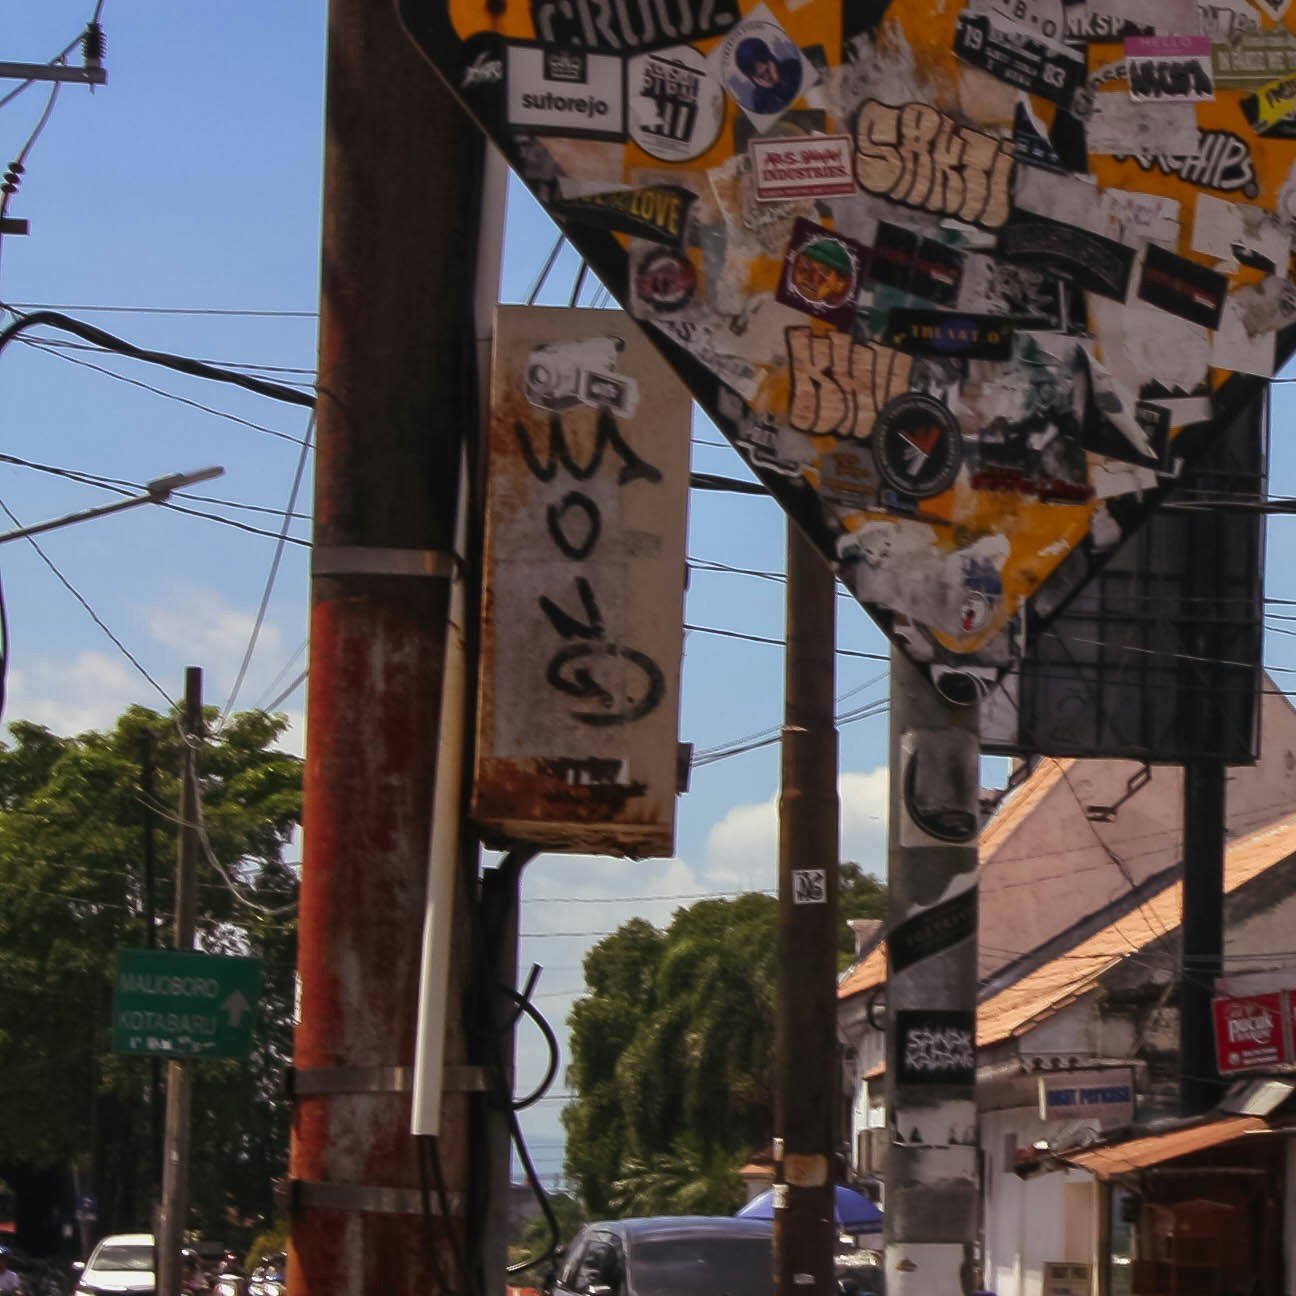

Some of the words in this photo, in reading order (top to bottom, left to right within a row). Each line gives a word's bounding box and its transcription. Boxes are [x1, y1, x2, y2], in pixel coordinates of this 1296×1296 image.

[1140, 37, 1192, 49] HELLO
[1041, 62, 1067, 89] 83
[522, 92, 608, 117] sutorejo
[631, 190, 681, 235] LOVE
[119, 973, 219, 999] MALIOBORO
[120, 1009, 217, 1035] KOTABARU
